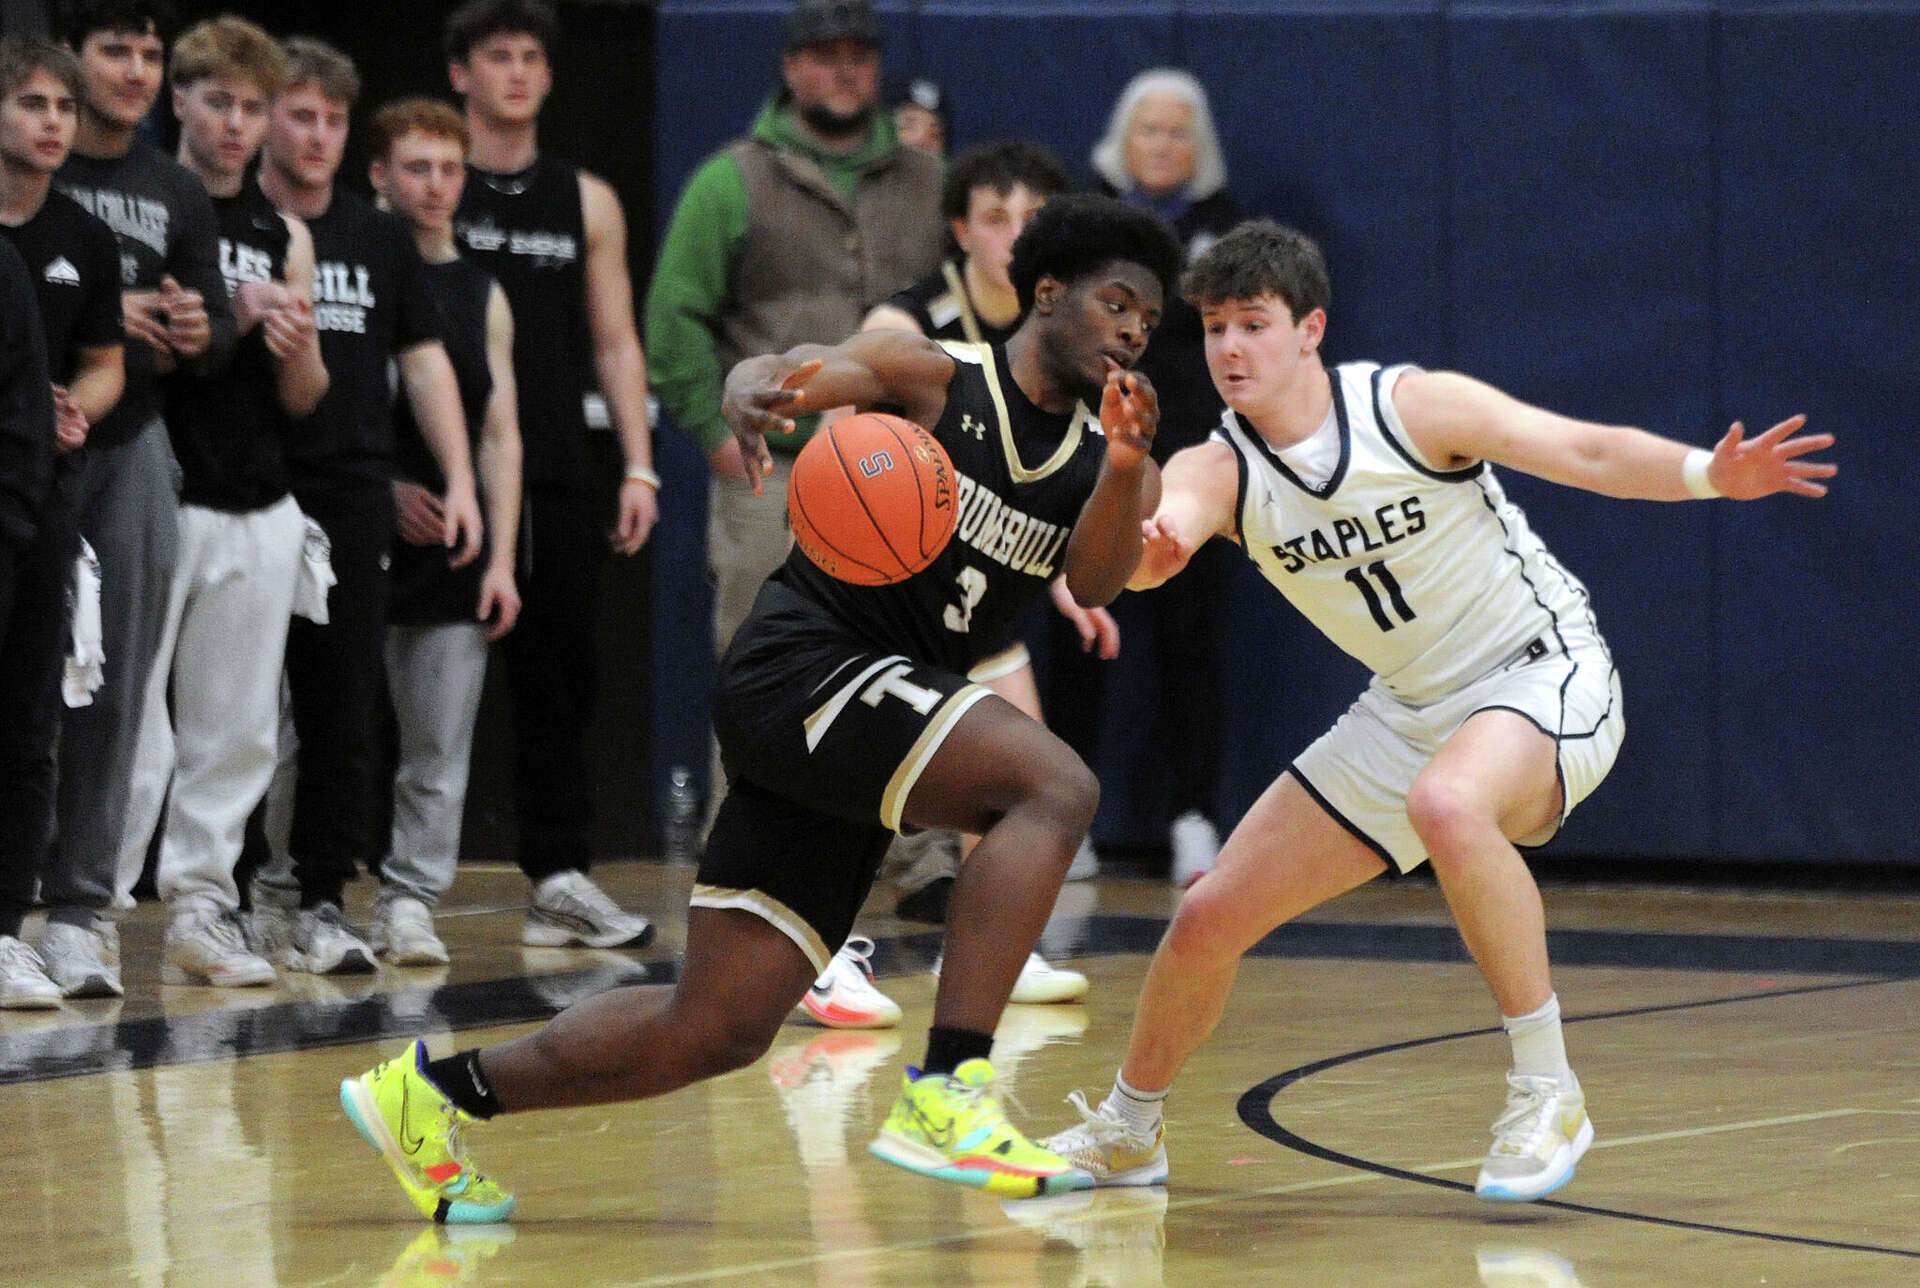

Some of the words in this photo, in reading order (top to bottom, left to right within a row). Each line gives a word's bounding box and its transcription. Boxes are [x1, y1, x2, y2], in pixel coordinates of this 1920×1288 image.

[955, 469, 1070, 578] RUMBULL
[1271, 496, 1426, 574] STAPLES
[1345, 560, 1417, 632] 11
[859, 664, 944, 716] T
